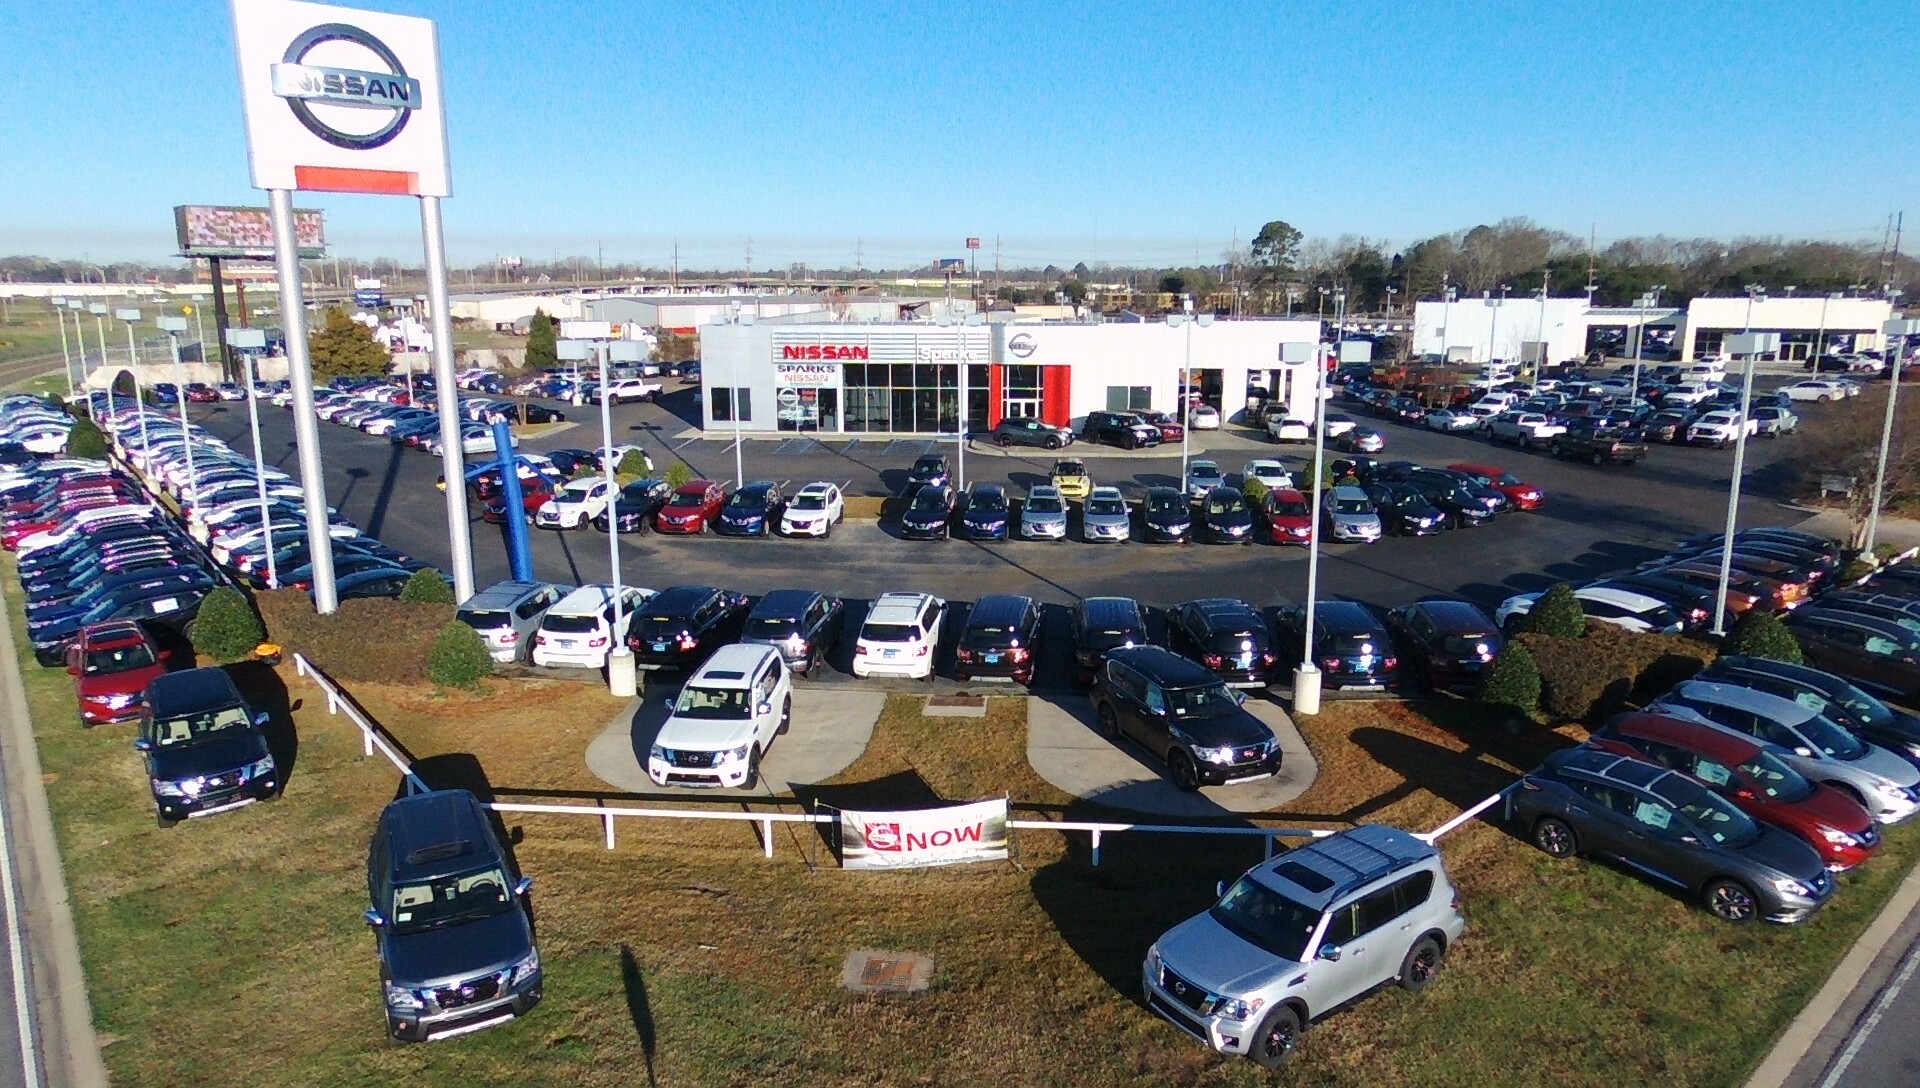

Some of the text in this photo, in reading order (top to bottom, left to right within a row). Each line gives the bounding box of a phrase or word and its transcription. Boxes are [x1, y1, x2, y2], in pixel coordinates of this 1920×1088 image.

[783, 345, 868, 360] NISSAN
[776, 365, 836, 374] SPARKS
[784, 374, 829, 383] NISSAN
[906, 822, 983, 851] NOW
